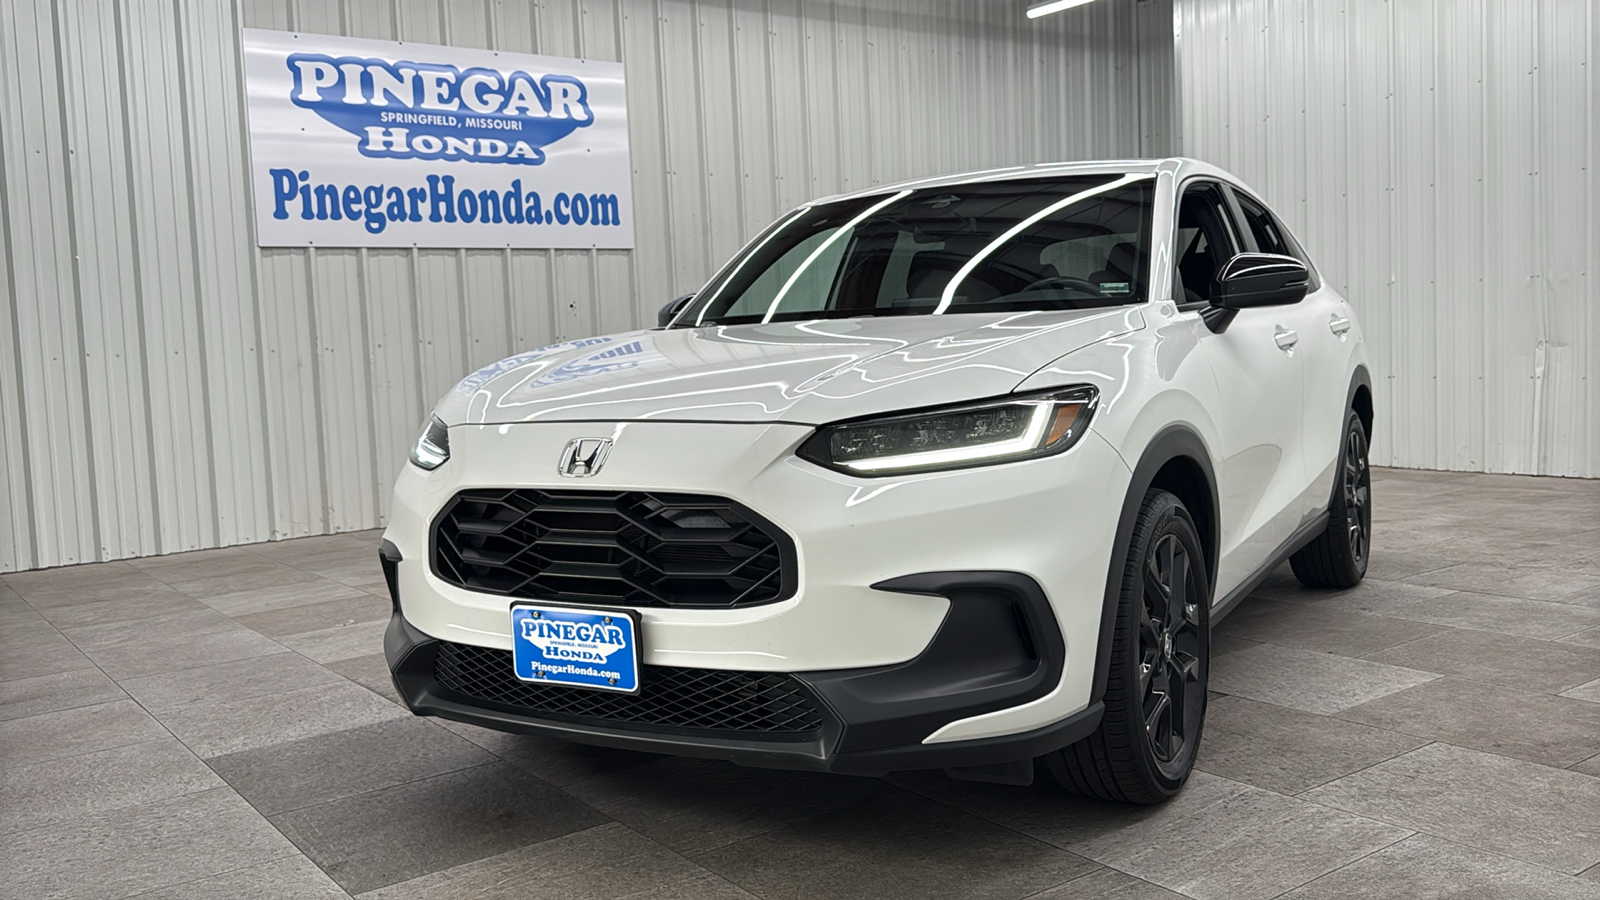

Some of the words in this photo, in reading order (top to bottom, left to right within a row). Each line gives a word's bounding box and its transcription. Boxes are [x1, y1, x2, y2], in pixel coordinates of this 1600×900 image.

[293, 60, 589, 121] PINEGAR
[380, 111, 462, 129] SPRINGFIELD,
[465, 117, 523, 131] MISSOURI
[363, 126, 540, 159] HONDA
[269, 168, 621, 234] PinegarHonda.com
[523, 621, 623, 646] PINEGAR
[545, 646, 605, 661] HONDA
[531, 661, 620, 679] PinegarHonda.com
